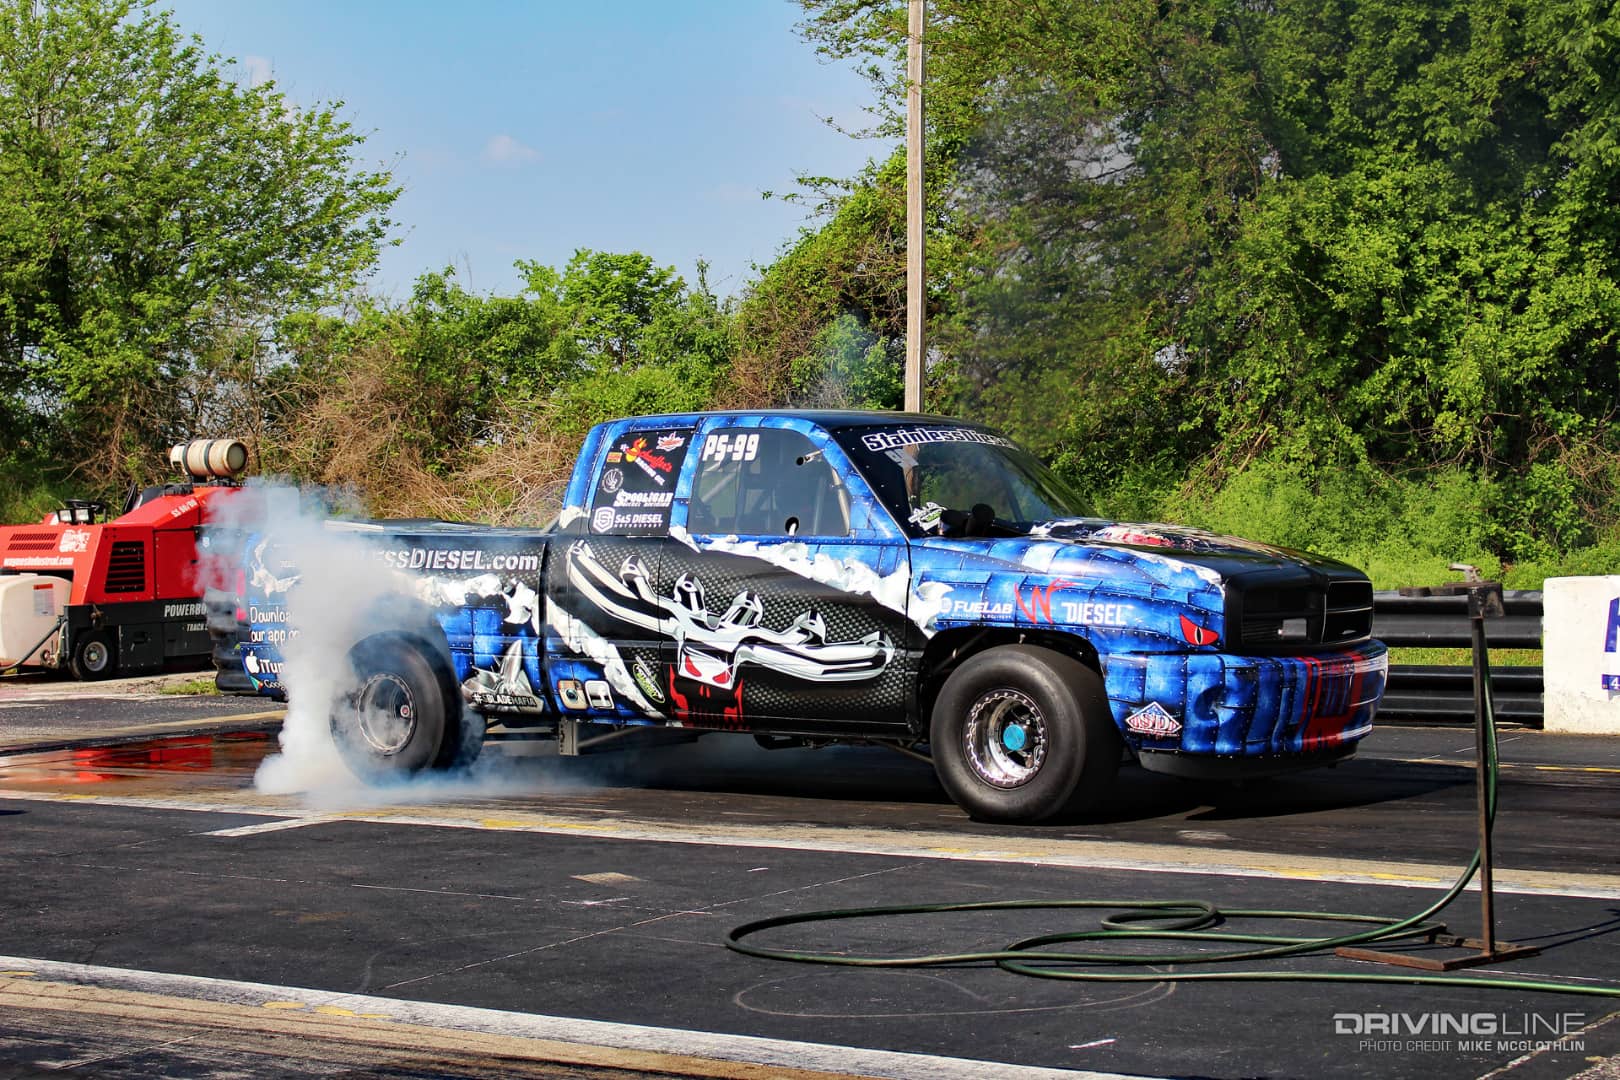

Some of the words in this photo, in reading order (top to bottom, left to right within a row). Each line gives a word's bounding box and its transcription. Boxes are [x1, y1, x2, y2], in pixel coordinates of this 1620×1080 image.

[702, 434, 760, 462] PS-99
[632, 513, 663, 524] DIESEL
[164, 603, 208, 617] POWERBO
[953, 601, 1014, 614] FUELAB
[1061, 602, 1127, 625] DIESEL
[268, 629, 286, 647] app
